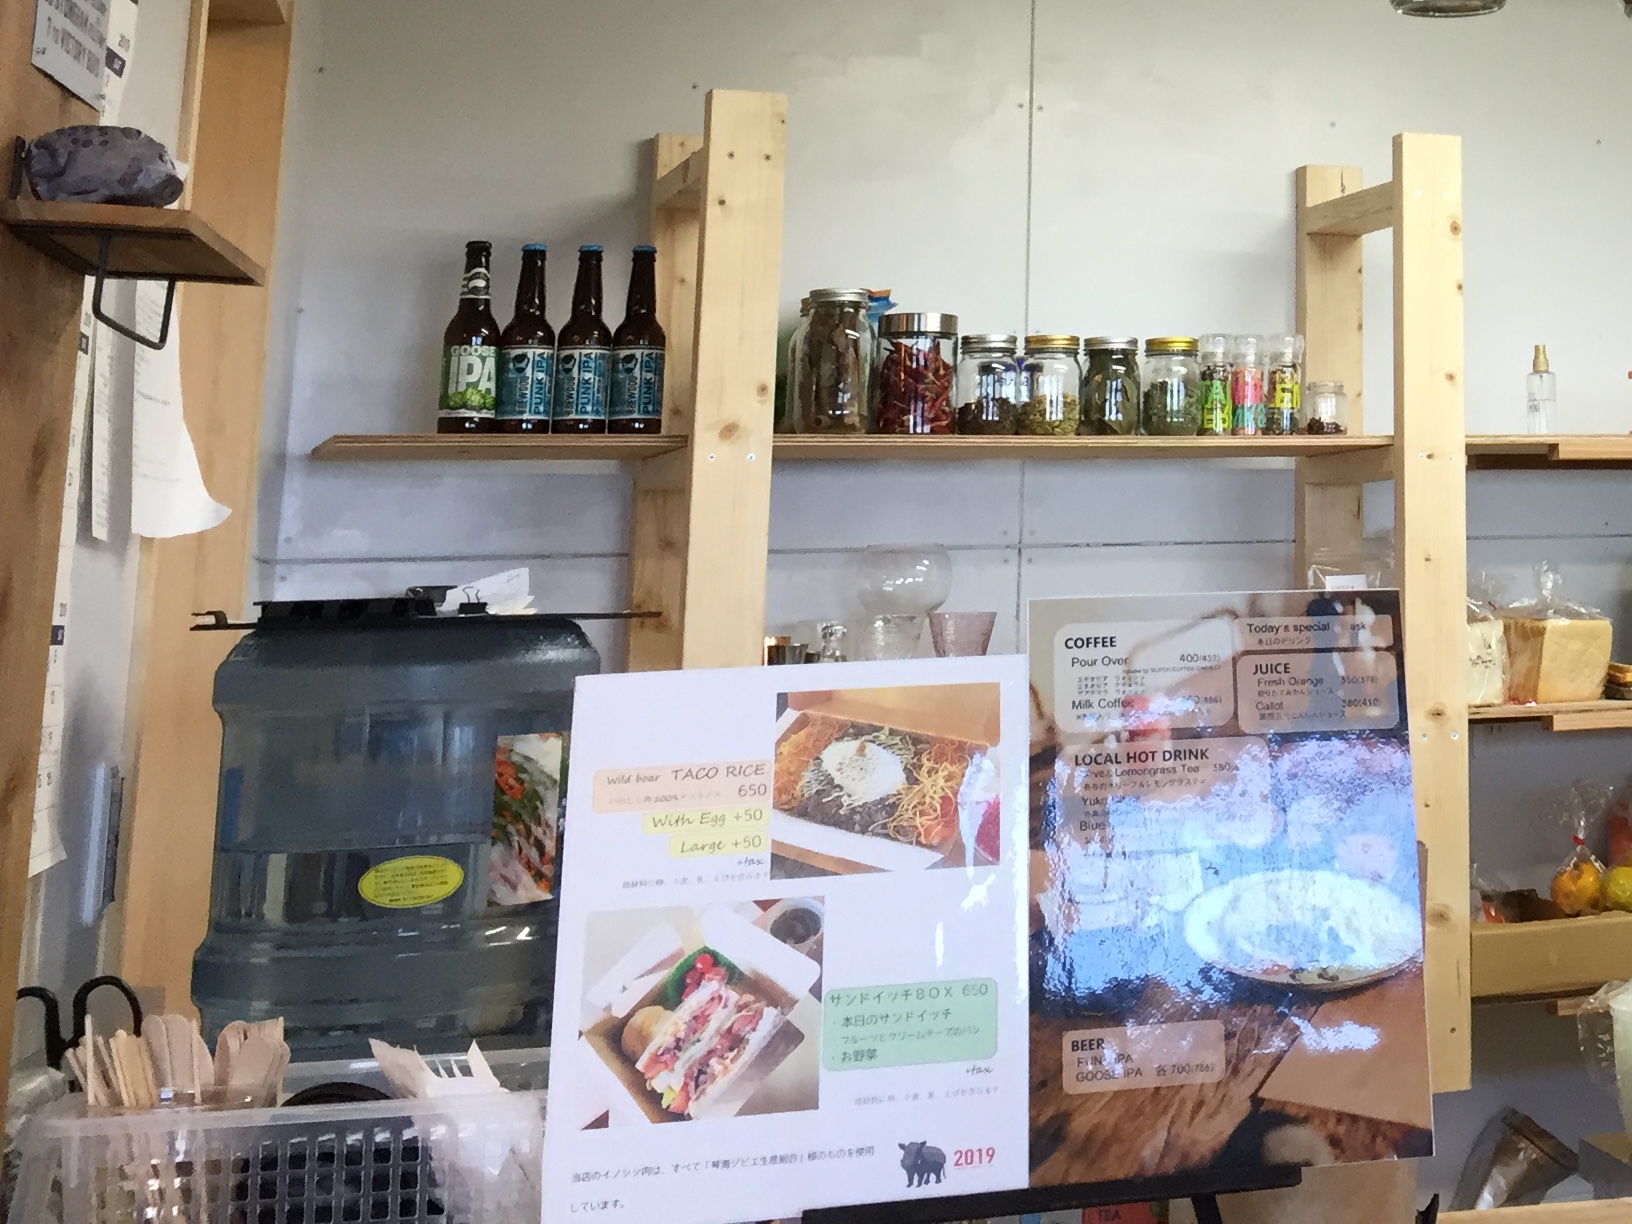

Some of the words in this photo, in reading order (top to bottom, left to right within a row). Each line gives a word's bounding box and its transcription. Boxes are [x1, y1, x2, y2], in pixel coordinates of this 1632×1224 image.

[450, 346, 497, 356] GOOSE
[535, 352, 547, 375] IPA
[581, 352, 594, 375] IPA
[643, 352, 655, 375] IPA
[448, 356, 497, 393] IPA
[534, 377, 546, 415] PUNK
[580, 377, 592, 415] PUNK
[642, 378, 654, 415] PUNK
[1247, 623, 1289, 635] Today's
[1292, 621, 1330, 635] special
[1064, 636, 1117, 650] COFFEE
[1071, 657, 1098, 667] Pour
[1100, 655, 1128, 667] Over
[1252, 663, 1291, 675] JUICE
[1257, 677, 1286, 687] Fresh
[1288, 676, 1324, 688] Orange
[1071, 698, 1096, 710] Milk
[1100, 697, 1135, 709] Coffee
[1074, 752, 1123, 767] LOCAL
[1126, 750, 1158, 764] HOT
[1162, 748, 1210, 763] DRINK
[607, 775, 632, 785] Wild
[636, 774, 661, 783] boar
[671, 767, 719, 781] TACO
[725, 763, 766, 777] RICE
[1115, 764, 1178, 779] Lemongrass
[1180, 763, 1201, 774] Tea
[737, 783, 767, 797] 650
[652, 814, 694, 828] With
[699, 812, 727, 827] Egg
[733, 808, 763, 823] +50
[1079, 820, 1106, 832] Blue
[680, 840, 727, 855] Large
[732, 835, 762, 849] +50
[737, 857, 766, 866] +tax
[962, 983, 988, 997] 650
[841, 1008, 952, 1028] 本日のサンドイッチ
[1071, 1038, 1105, 1052] BEER
[966, 1065, 994, 1076] +tax
[1123, 1067, 1143, 1079] IPA
[953, 1147, 996, 1167] 2019
